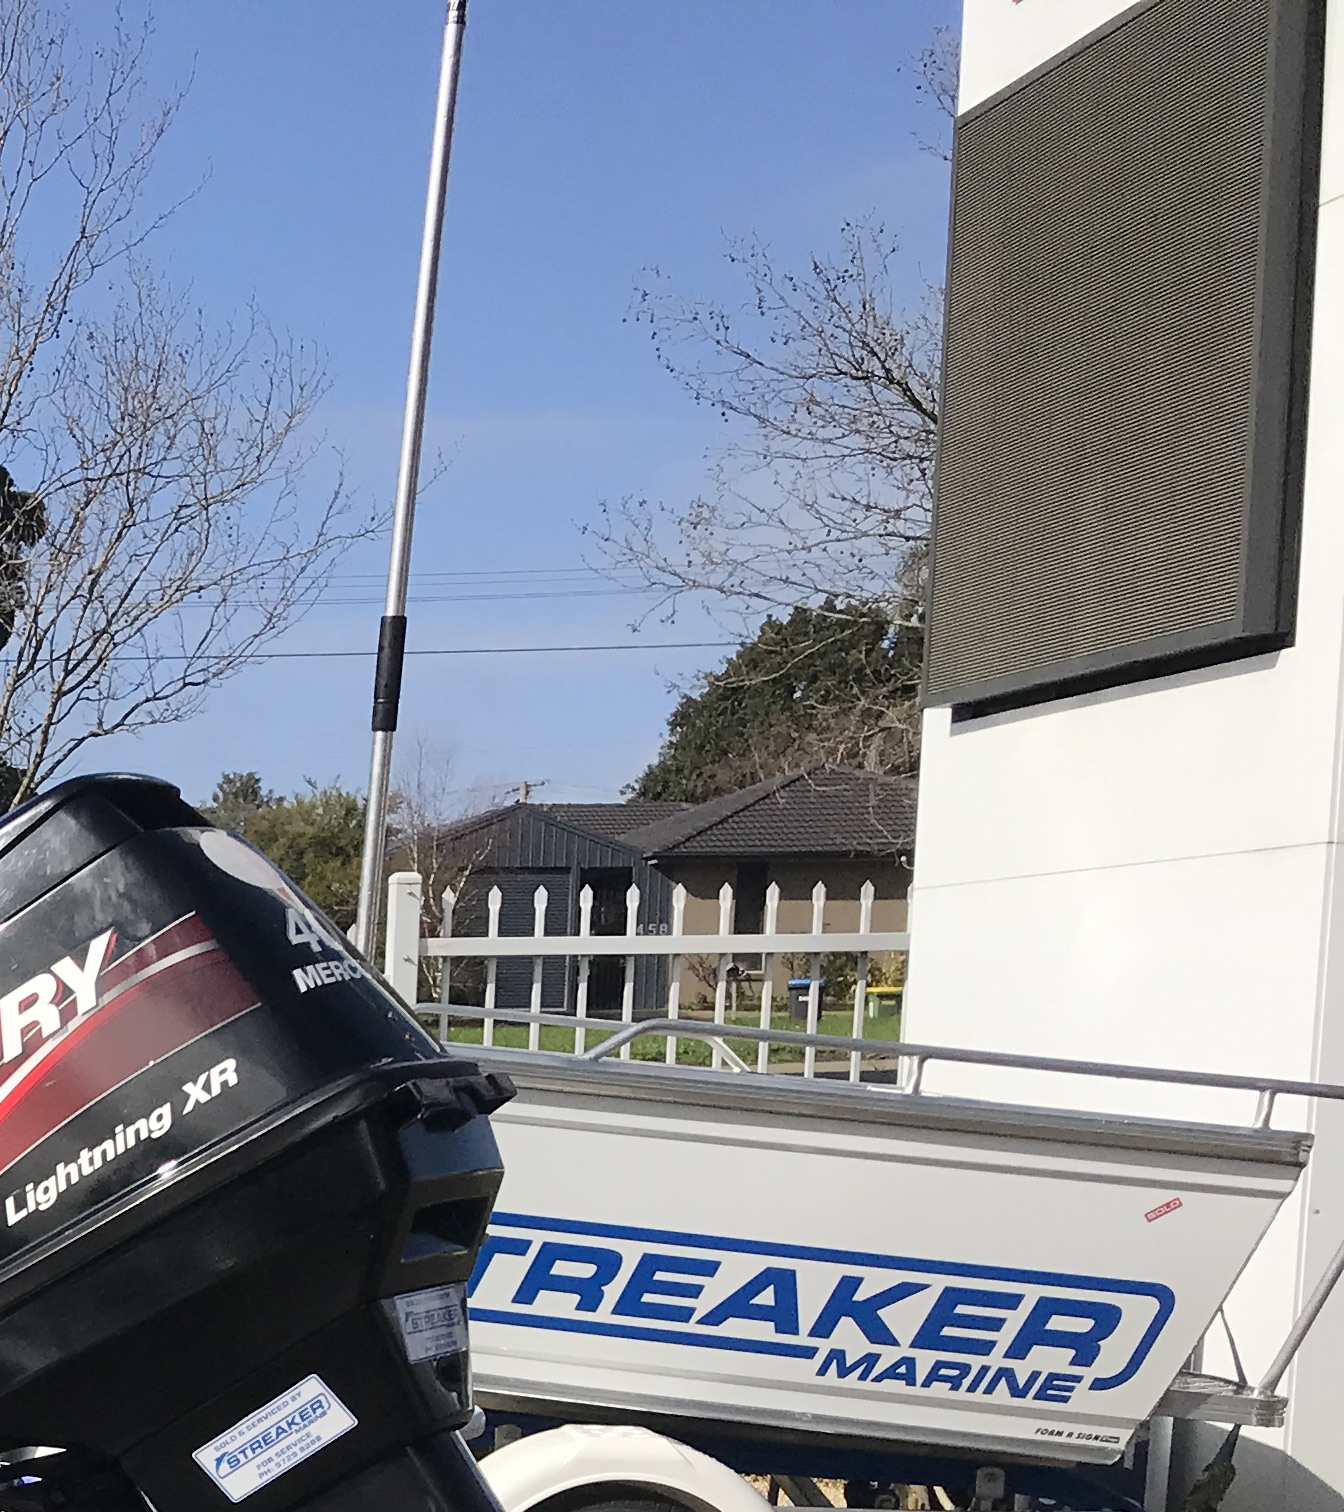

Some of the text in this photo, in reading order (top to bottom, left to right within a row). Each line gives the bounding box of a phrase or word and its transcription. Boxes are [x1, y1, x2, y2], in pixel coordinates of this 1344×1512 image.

[4, 1057, 239, 1227] Lightning XR
[1147, 1200, 1180, 1220] SOLD
[815, 1351, 1086, 1404] MARINE
[214, 1435, 237, 1452] SOLD
[246, 1401, 289, 1432] SERVICED
[227, 1399, 325, 1470] STREAKER
[294, 1410, 328, 1435] MARINE
[256, 1432, 313, 1471] FOR SERVICE
